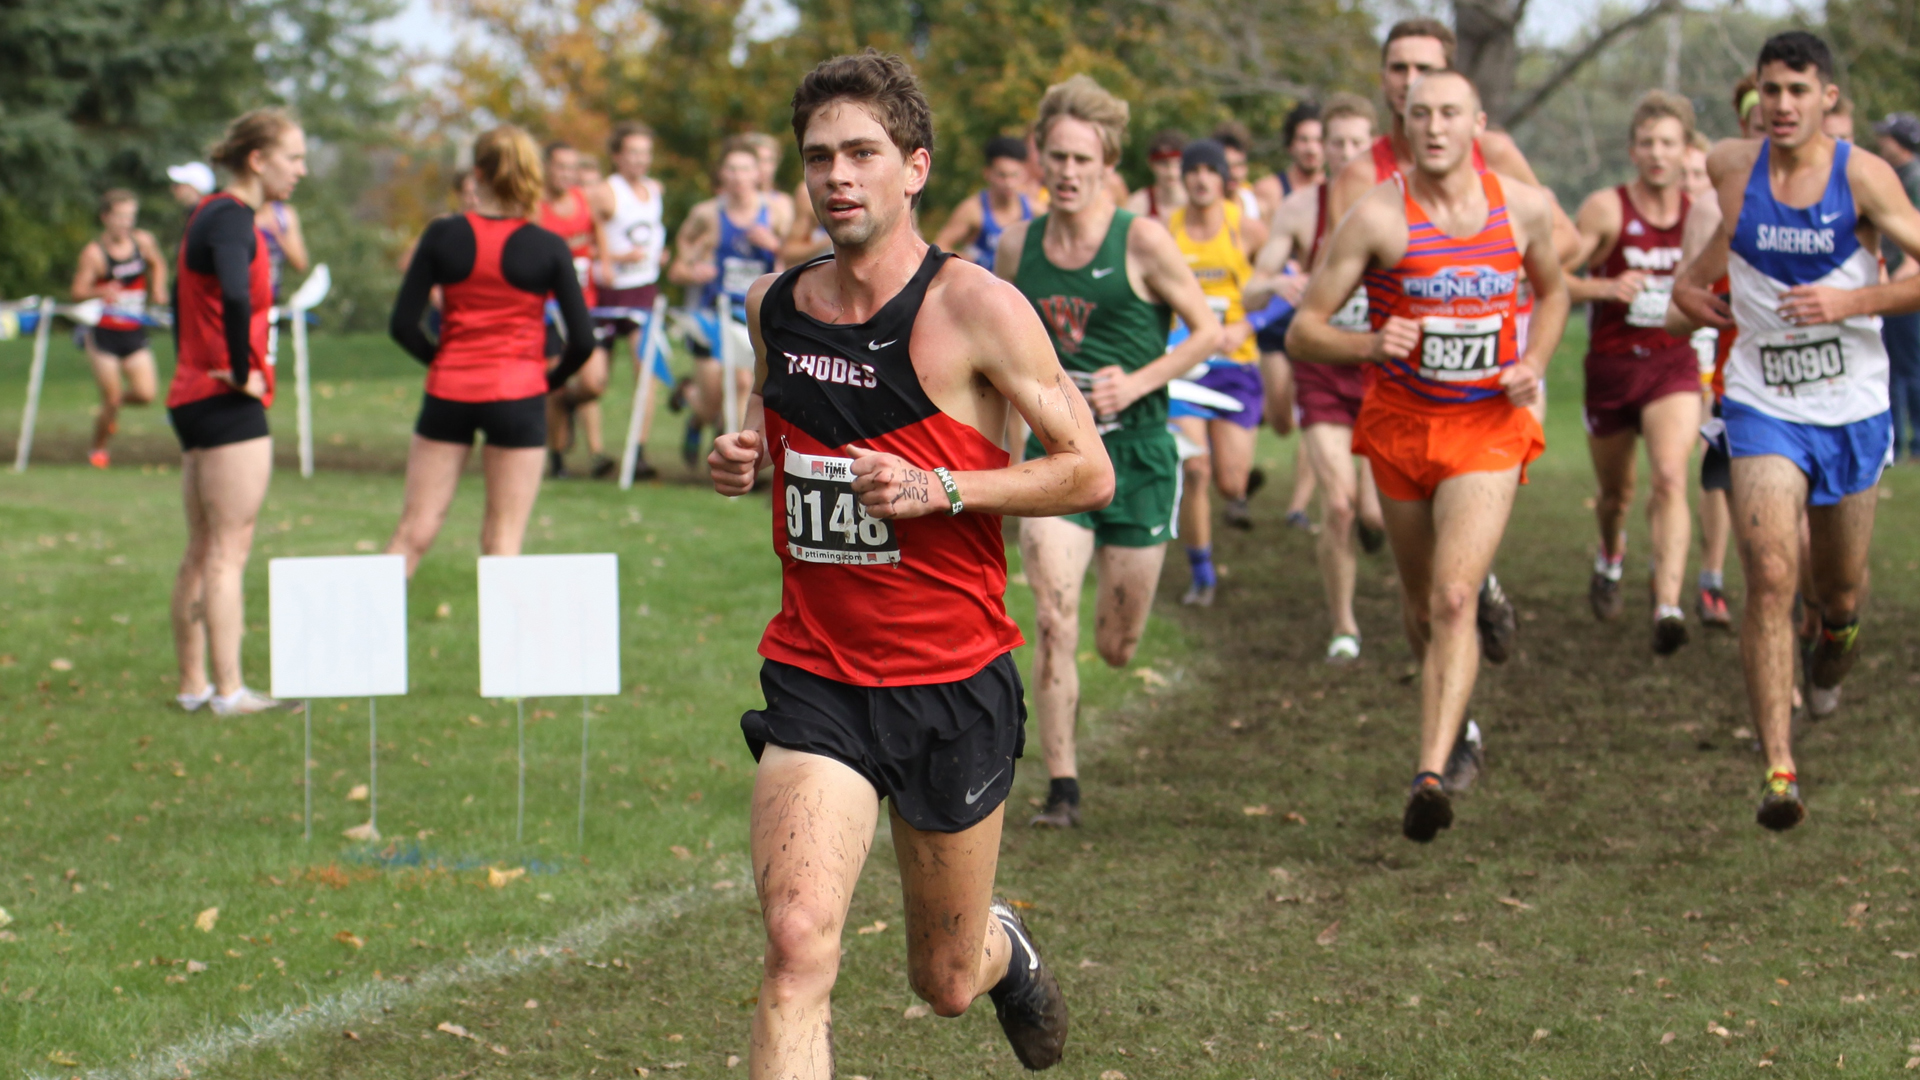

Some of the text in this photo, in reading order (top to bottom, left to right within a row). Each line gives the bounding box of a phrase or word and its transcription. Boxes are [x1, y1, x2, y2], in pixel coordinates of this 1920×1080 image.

[1756, 223, 1834, 254] SAGEHENS
[1422, 335, 1497, 369] 9371
[1763, 342, 1841, 384] 9090
[783, 352, 878, 388] RHODES
[824, 465, 847, 475] TIME
[902, 468, 929, 485] FAST
[785, 484, 889, 546] 9148
[805, 550, 863, 561] pttiming.com
